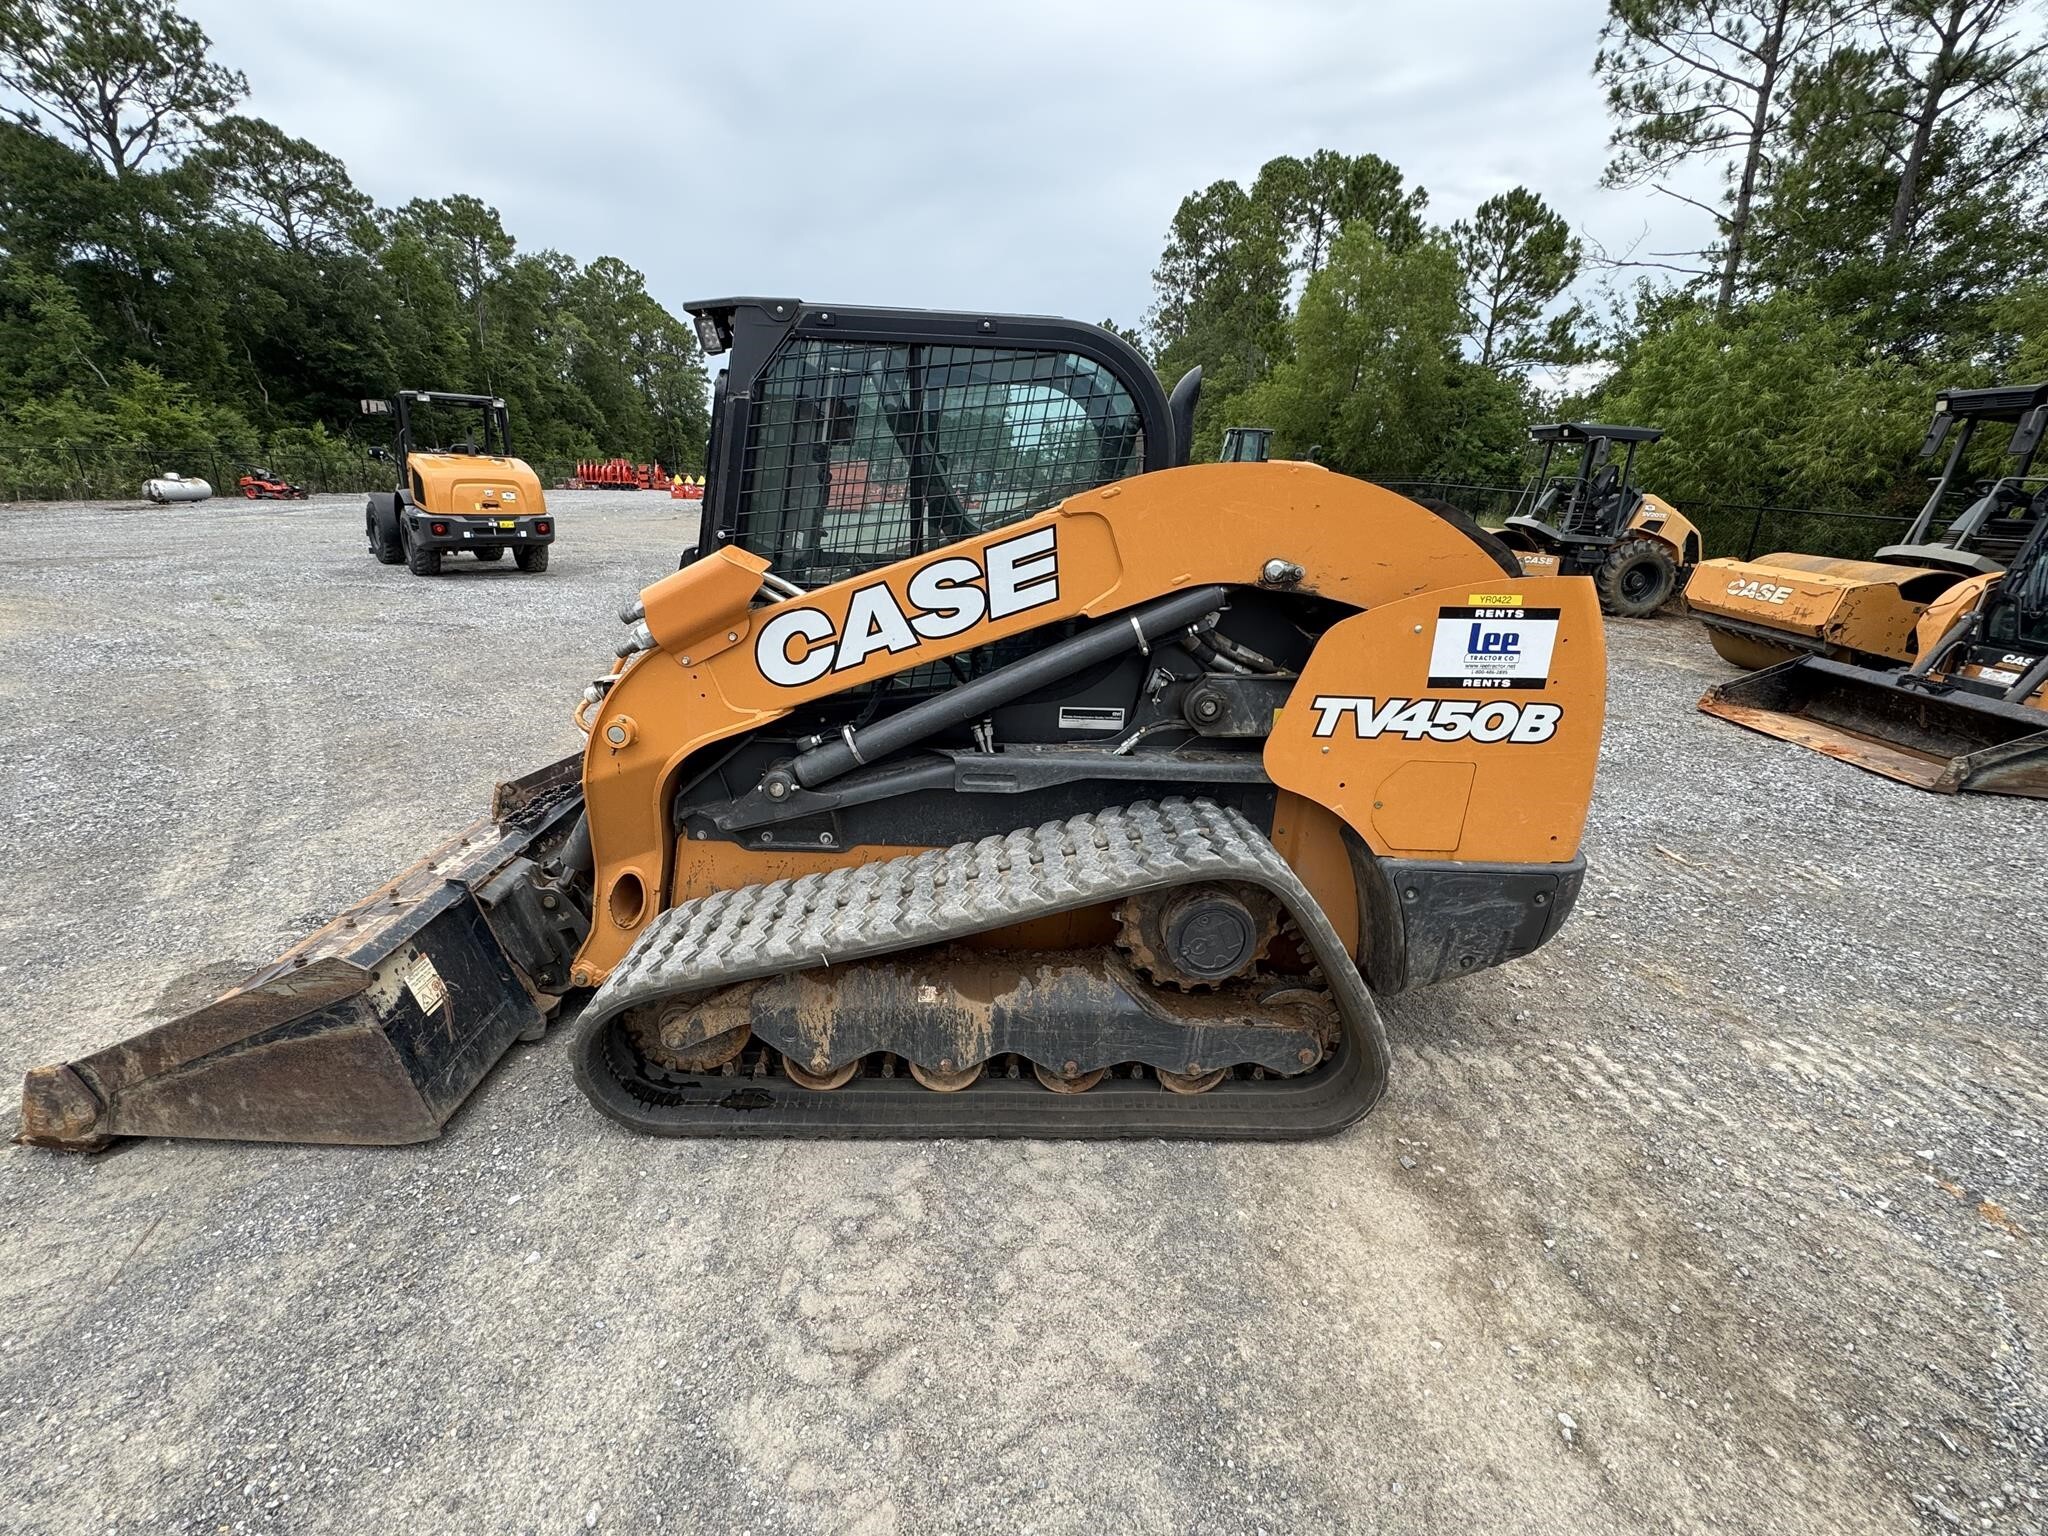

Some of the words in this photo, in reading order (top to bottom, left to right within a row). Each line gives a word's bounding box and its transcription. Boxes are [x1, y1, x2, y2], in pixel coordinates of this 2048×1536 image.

[1524, 556, 1553, 565] CASE
[1726, 578, 1795, 605] CASE
[755, 523, 1060, 687] CASE
[1480, 595, 1512, 604] YR0422
[1475, 609, 1525, 618] RENTS
[2002, 654, 2035, 667] CAS
[1462, 679, 1511, 688] RENTS
[1310, 695, 1565, 744] TV450B
